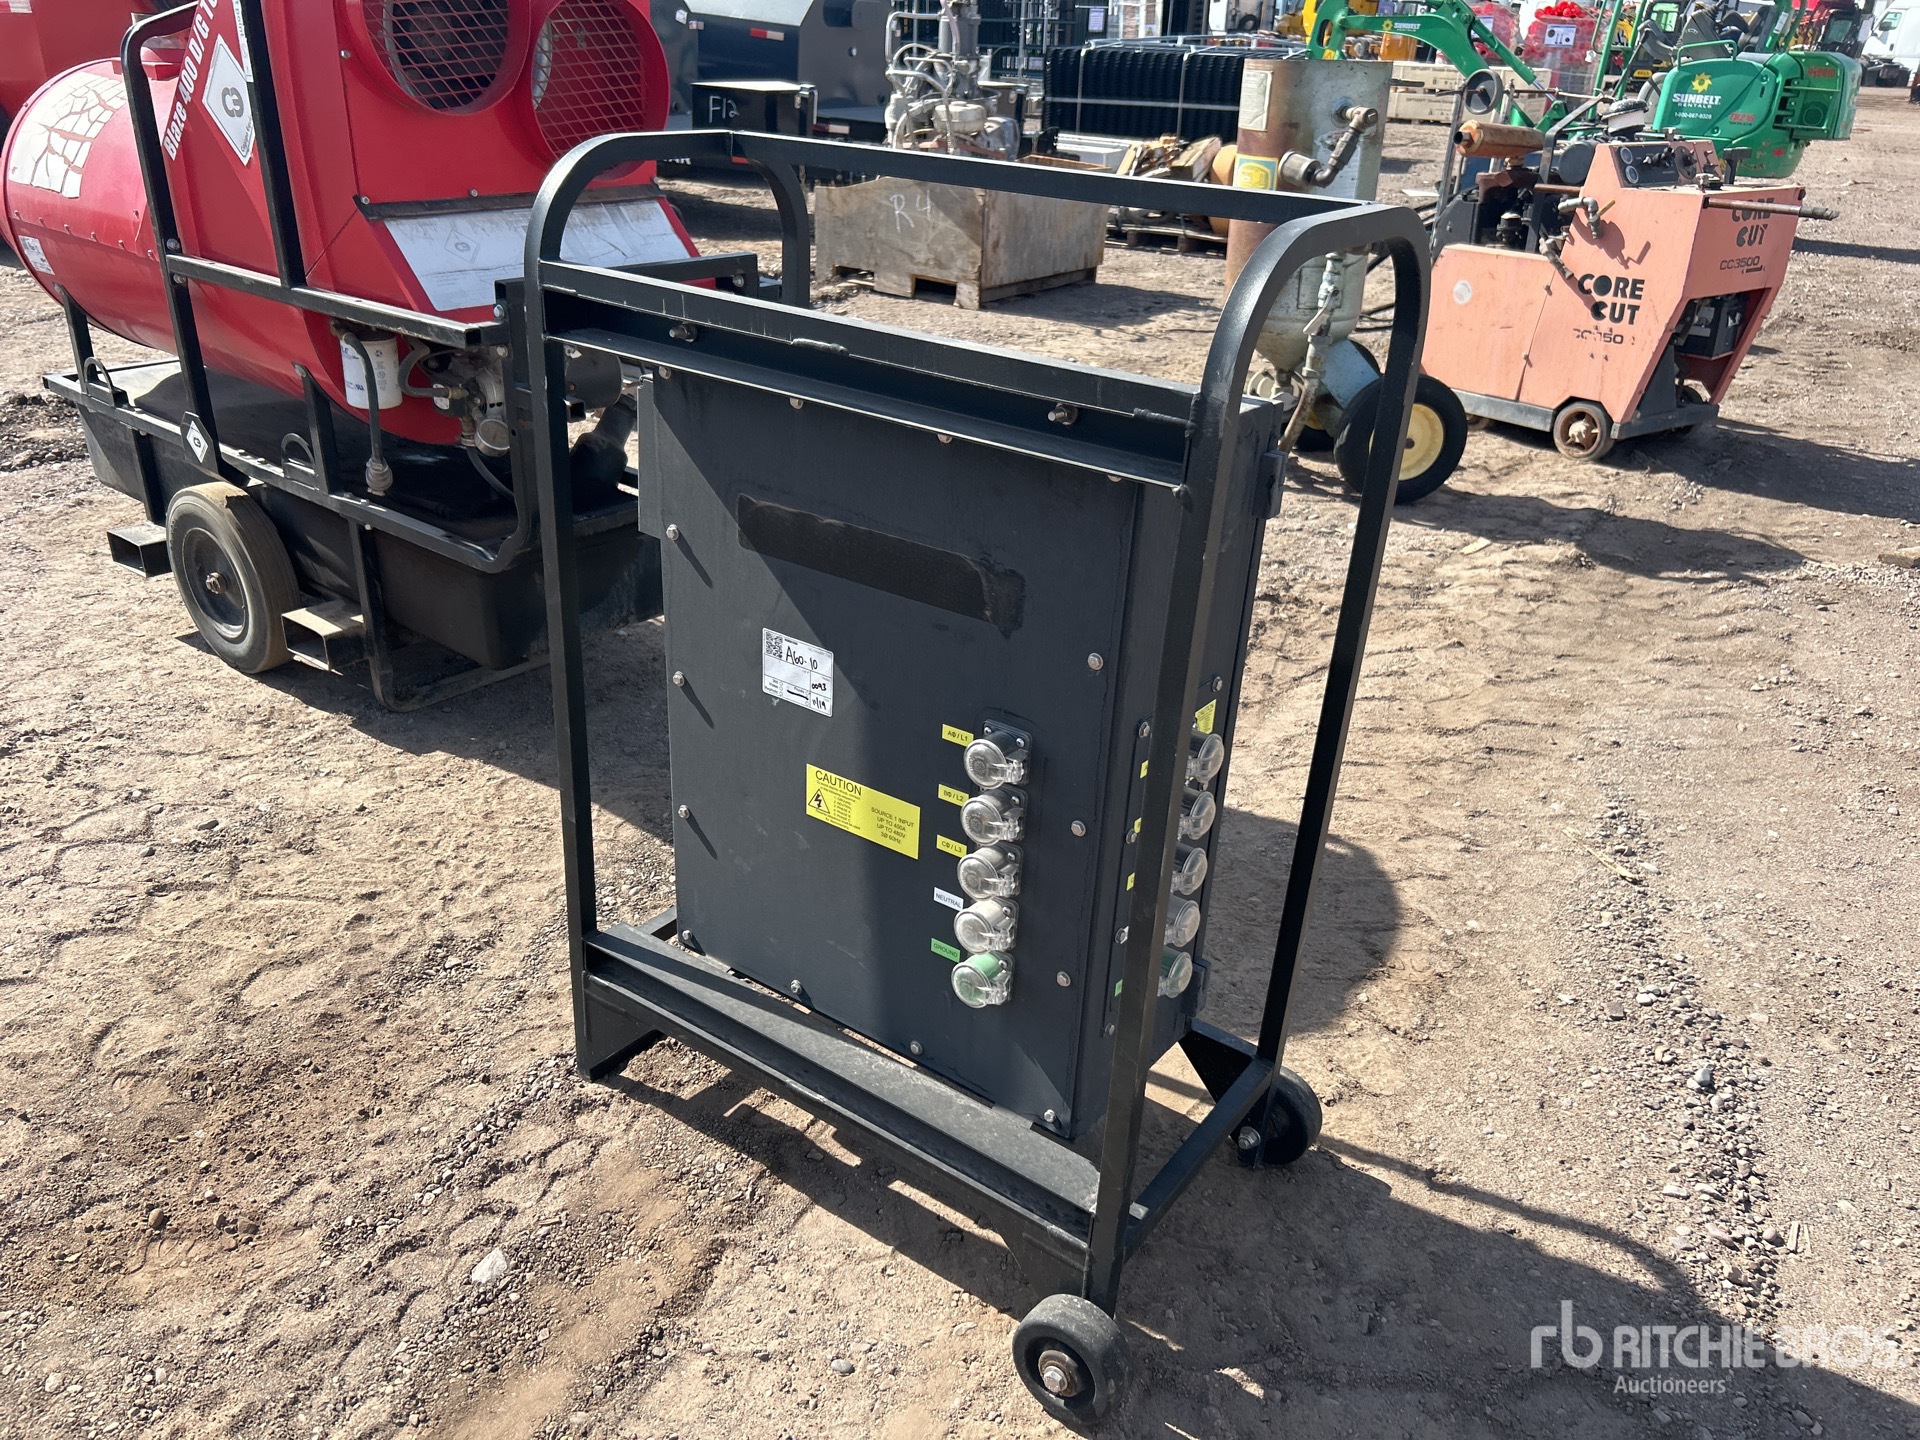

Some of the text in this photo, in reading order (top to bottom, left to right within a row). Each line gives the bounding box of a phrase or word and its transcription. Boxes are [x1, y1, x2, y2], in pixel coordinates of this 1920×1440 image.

[162, 101, 187, 161] Blaze
[178, 56, 198, 104] 400
[188, 13, 210, 64] D/G
[709, 95, 740, 123] F12
[1672, 93, 1721, 105] SUNBELT
[1736, 224, 1768, 247] CUT
[1720, 256, 1760, 270] CC3500
[1578, 274, 1645, 300] CORE
[1591, 301, 1640, 325] CUT
[816, 770, 862, 796] CAUTION
[871, 807, 892, 820] SOURCE
[898, 818, 914, 828] INPUT
[936, 893, 961, 908] NEUTRAL
[934, 943, 958, 958] GROUND
